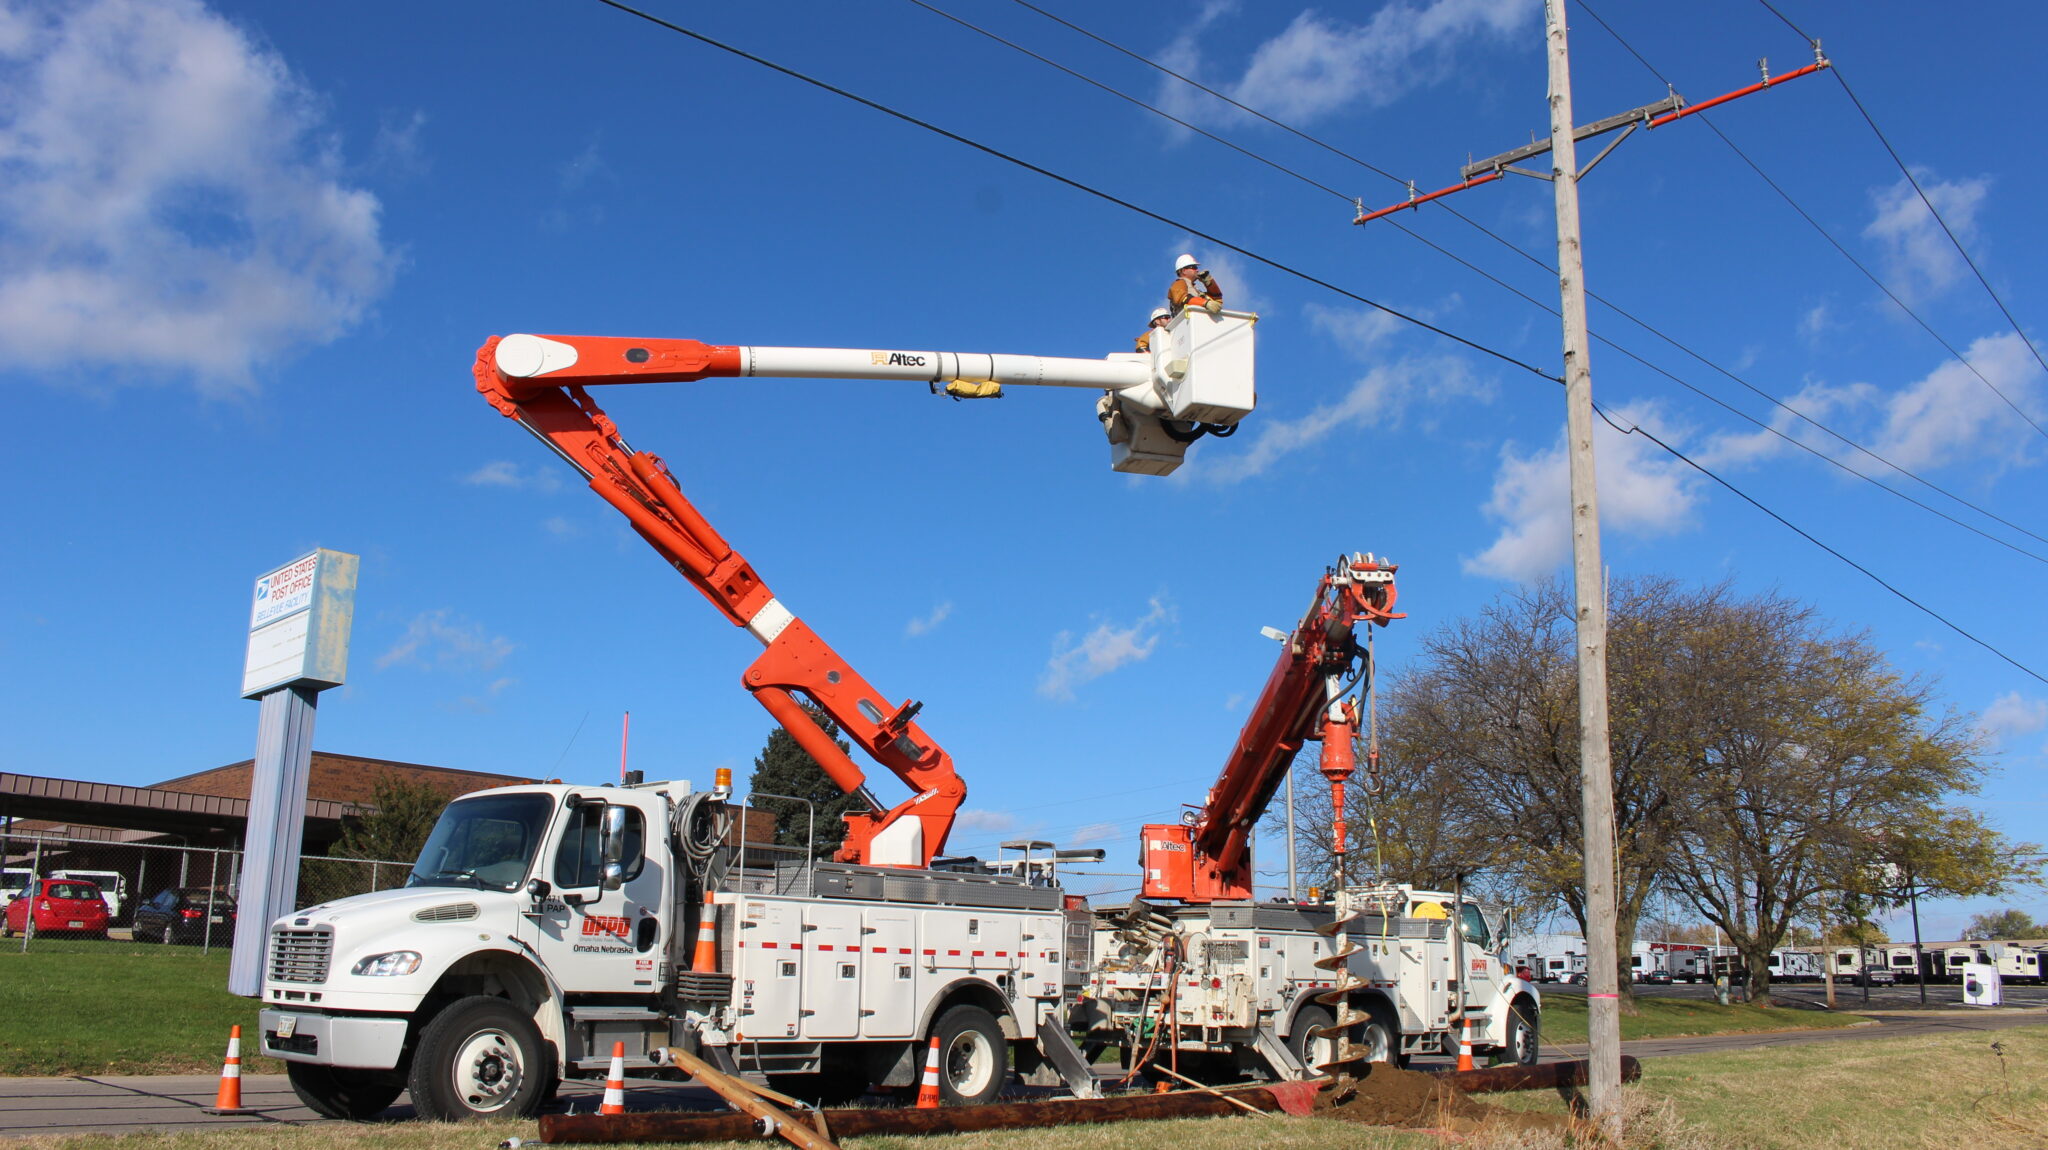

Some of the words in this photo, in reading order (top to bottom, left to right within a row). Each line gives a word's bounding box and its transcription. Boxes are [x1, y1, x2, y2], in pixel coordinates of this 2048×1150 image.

[889, 352, 926, 367] Altec
[271, 568, 293, 588] UNITED
[295, 557, 317, 577] STATES
[272, 585, 293, 602] POST
[290, 574, 312, 594] OFFICE
[1161, 841, 1186, 852] Altec
[547, 904, 565, 912] PAP
[582, 916, 631, 937] OPPD
[601, 945, 634, 954] Nebraska
